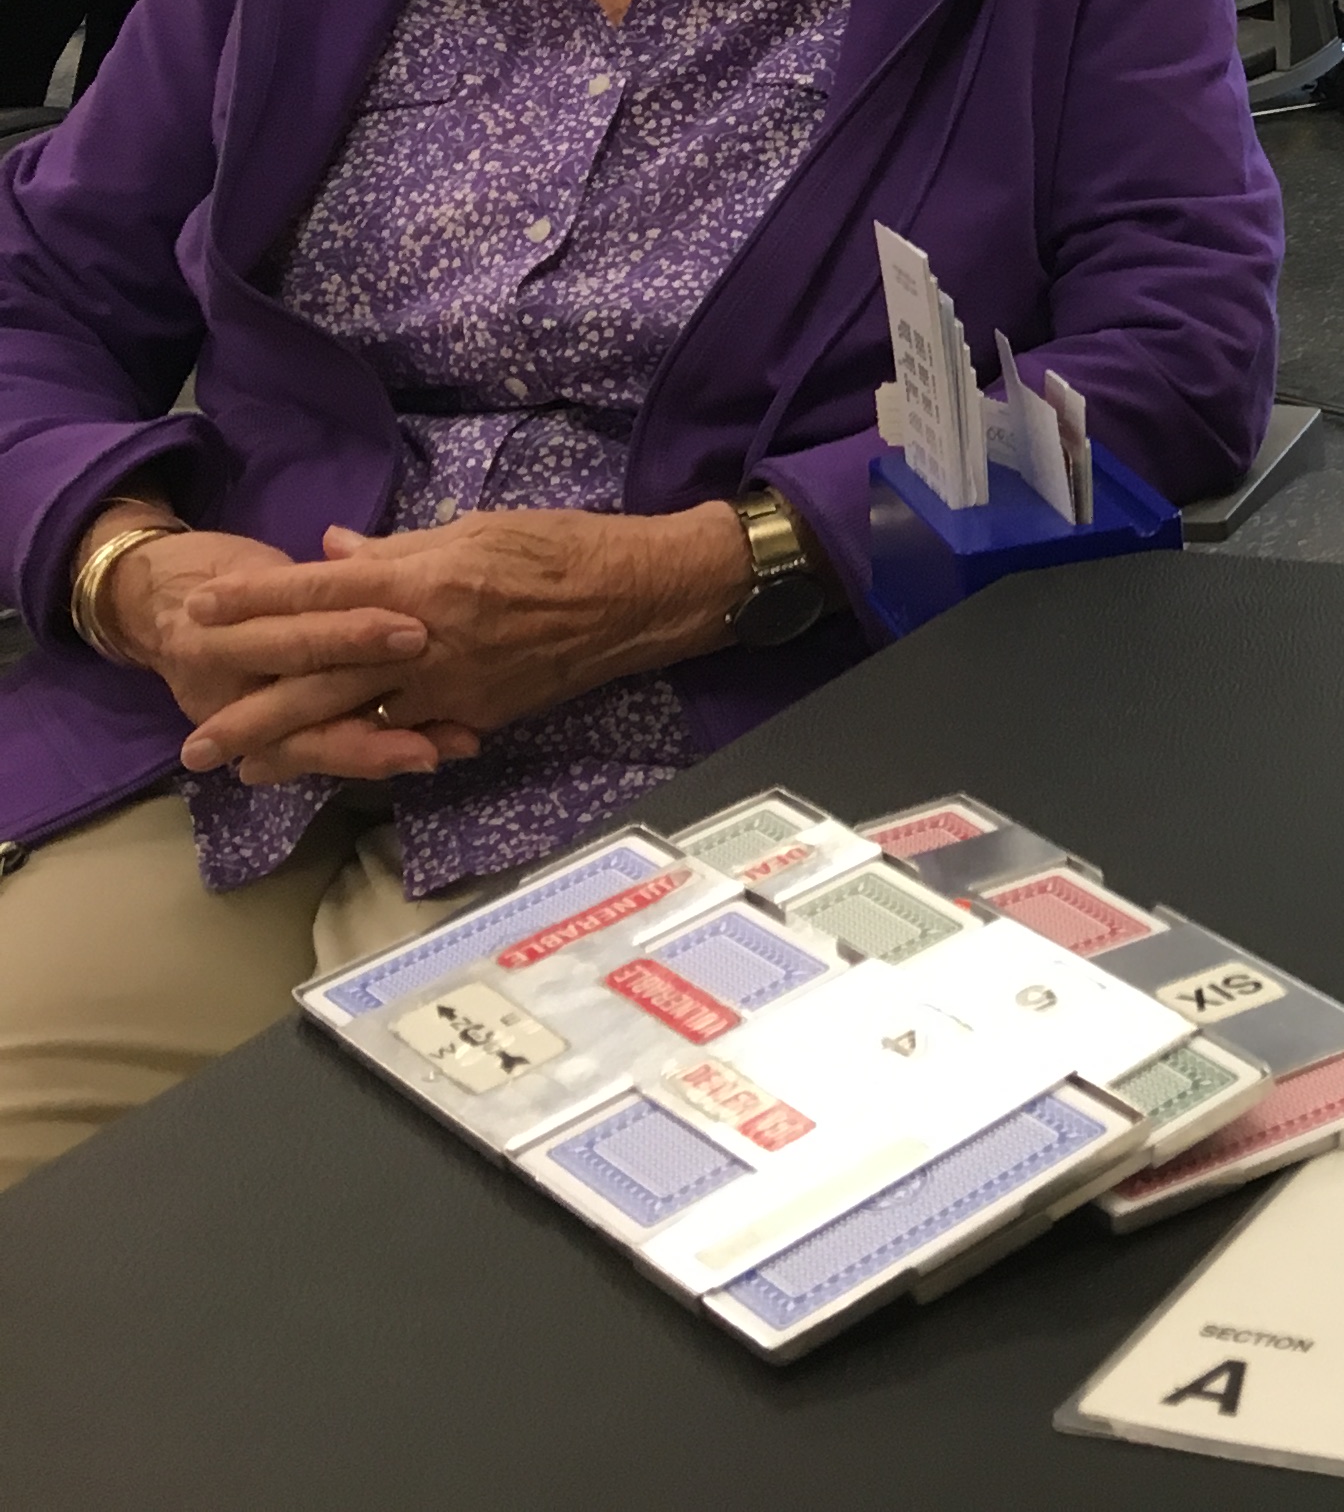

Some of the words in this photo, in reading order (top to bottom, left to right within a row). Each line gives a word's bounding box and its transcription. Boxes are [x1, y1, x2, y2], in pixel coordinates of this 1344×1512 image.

[1174, 973, 1264, 1013] SIX
[1198, 1323, 1318, 1355] SECTION
[1158, 1358, 1249, 1418] A
